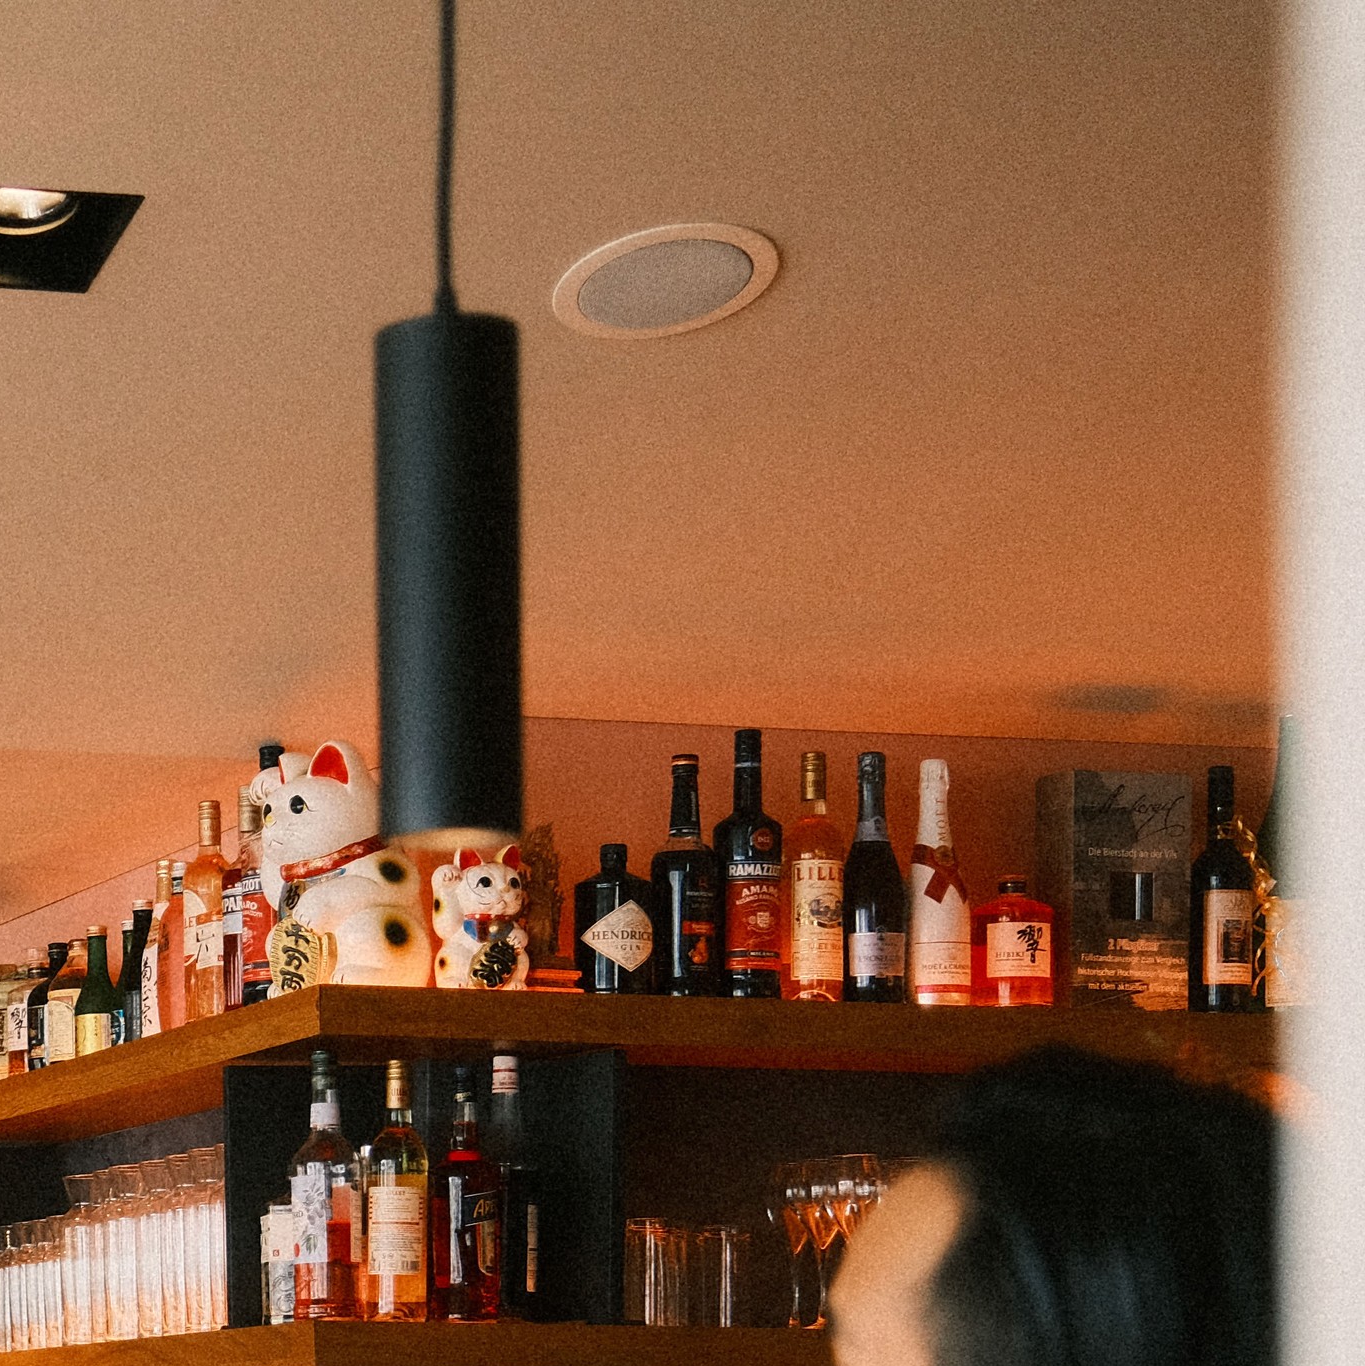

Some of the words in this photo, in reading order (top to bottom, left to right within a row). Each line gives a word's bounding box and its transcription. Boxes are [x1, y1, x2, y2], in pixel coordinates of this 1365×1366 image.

[1088, 847, 1101, 857] Die
[1139, 850, 1149, 858] an
[1150, 848, 1163, 858] der
[1017, 924, 1047, 964] 響
[1107, 938, 1115, 950] 2
[995, 951, 1025, 959] HIBIKI
[1088, 982, 1100, 990] mit
[1101, 982, 1116, 990] dem
